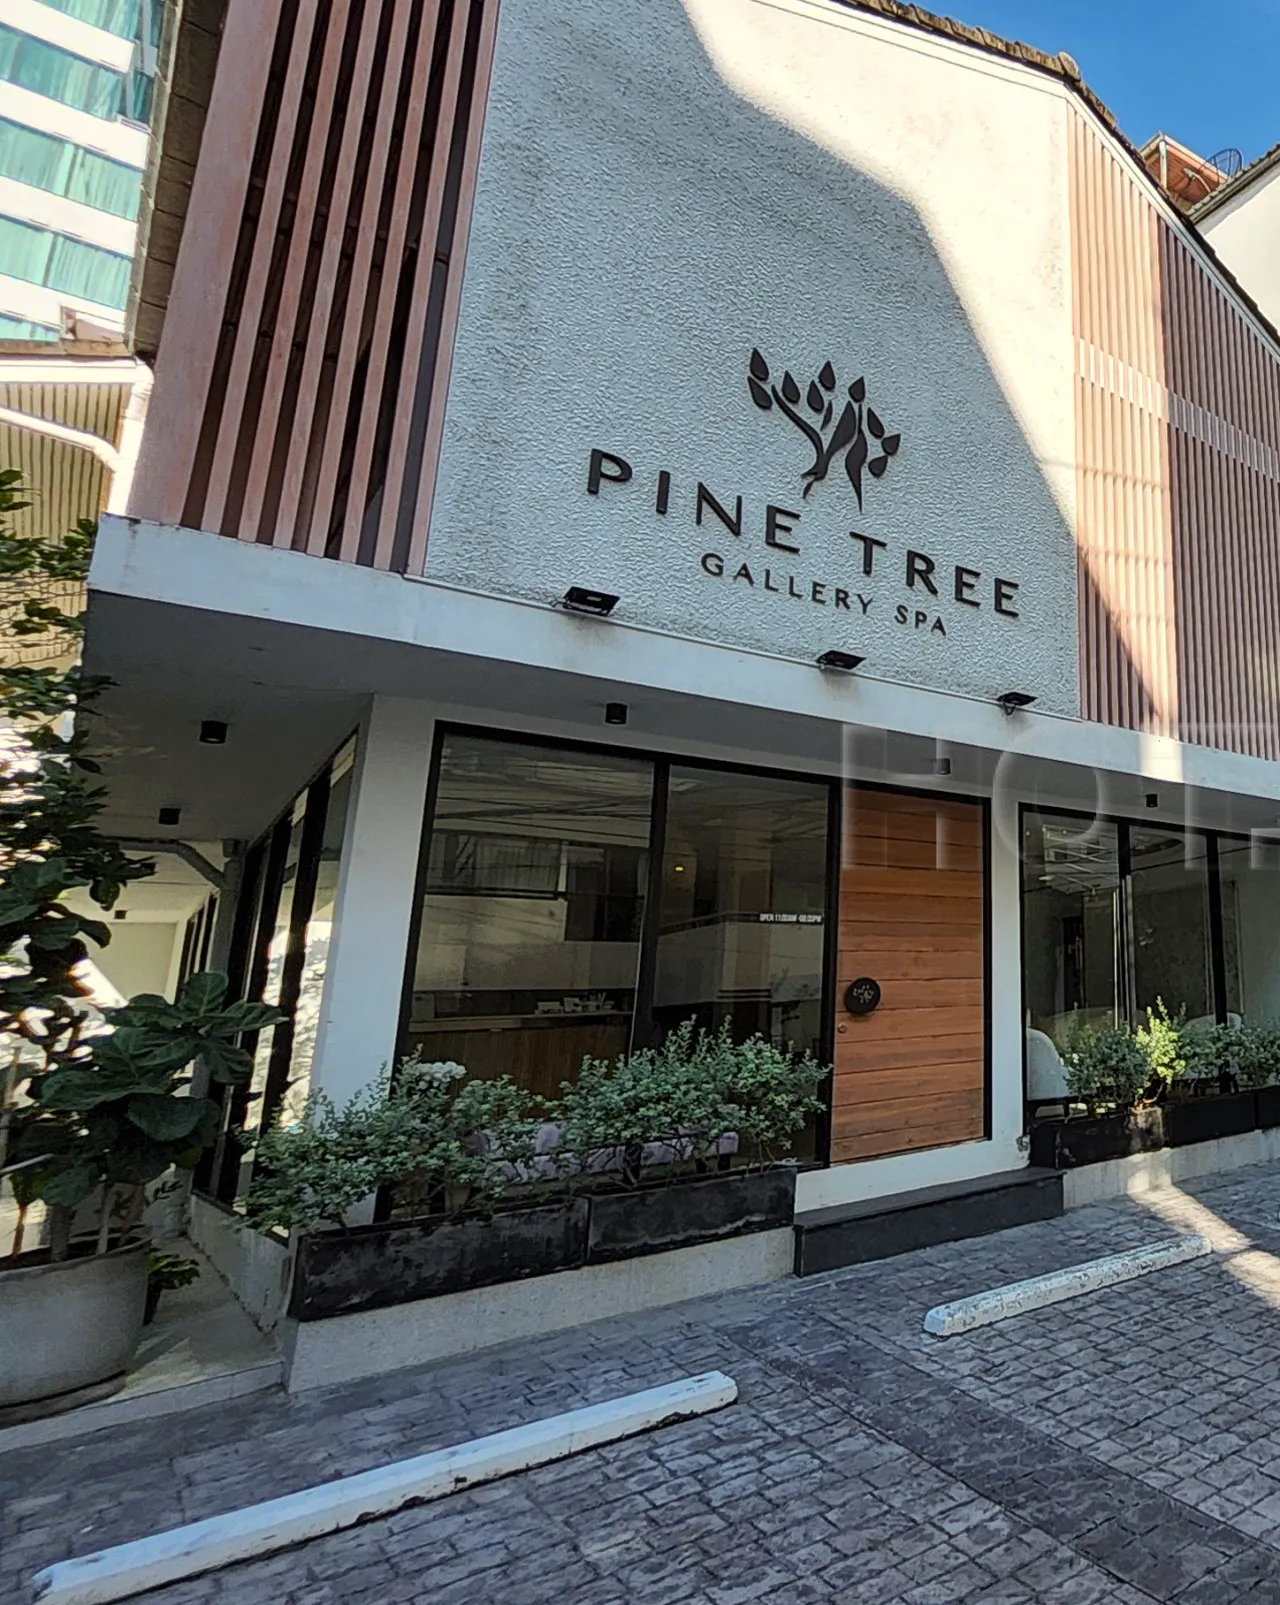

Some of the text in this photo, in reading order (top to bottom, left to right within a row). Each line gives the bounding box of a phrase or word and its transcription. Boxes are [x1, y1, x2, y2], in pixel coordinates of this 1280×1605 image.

[587, 448, 1019, 618] PINE TREE
[701, 552, 947, 636] GALLERY SPA
[760, 913, 774, 922] OPEN
